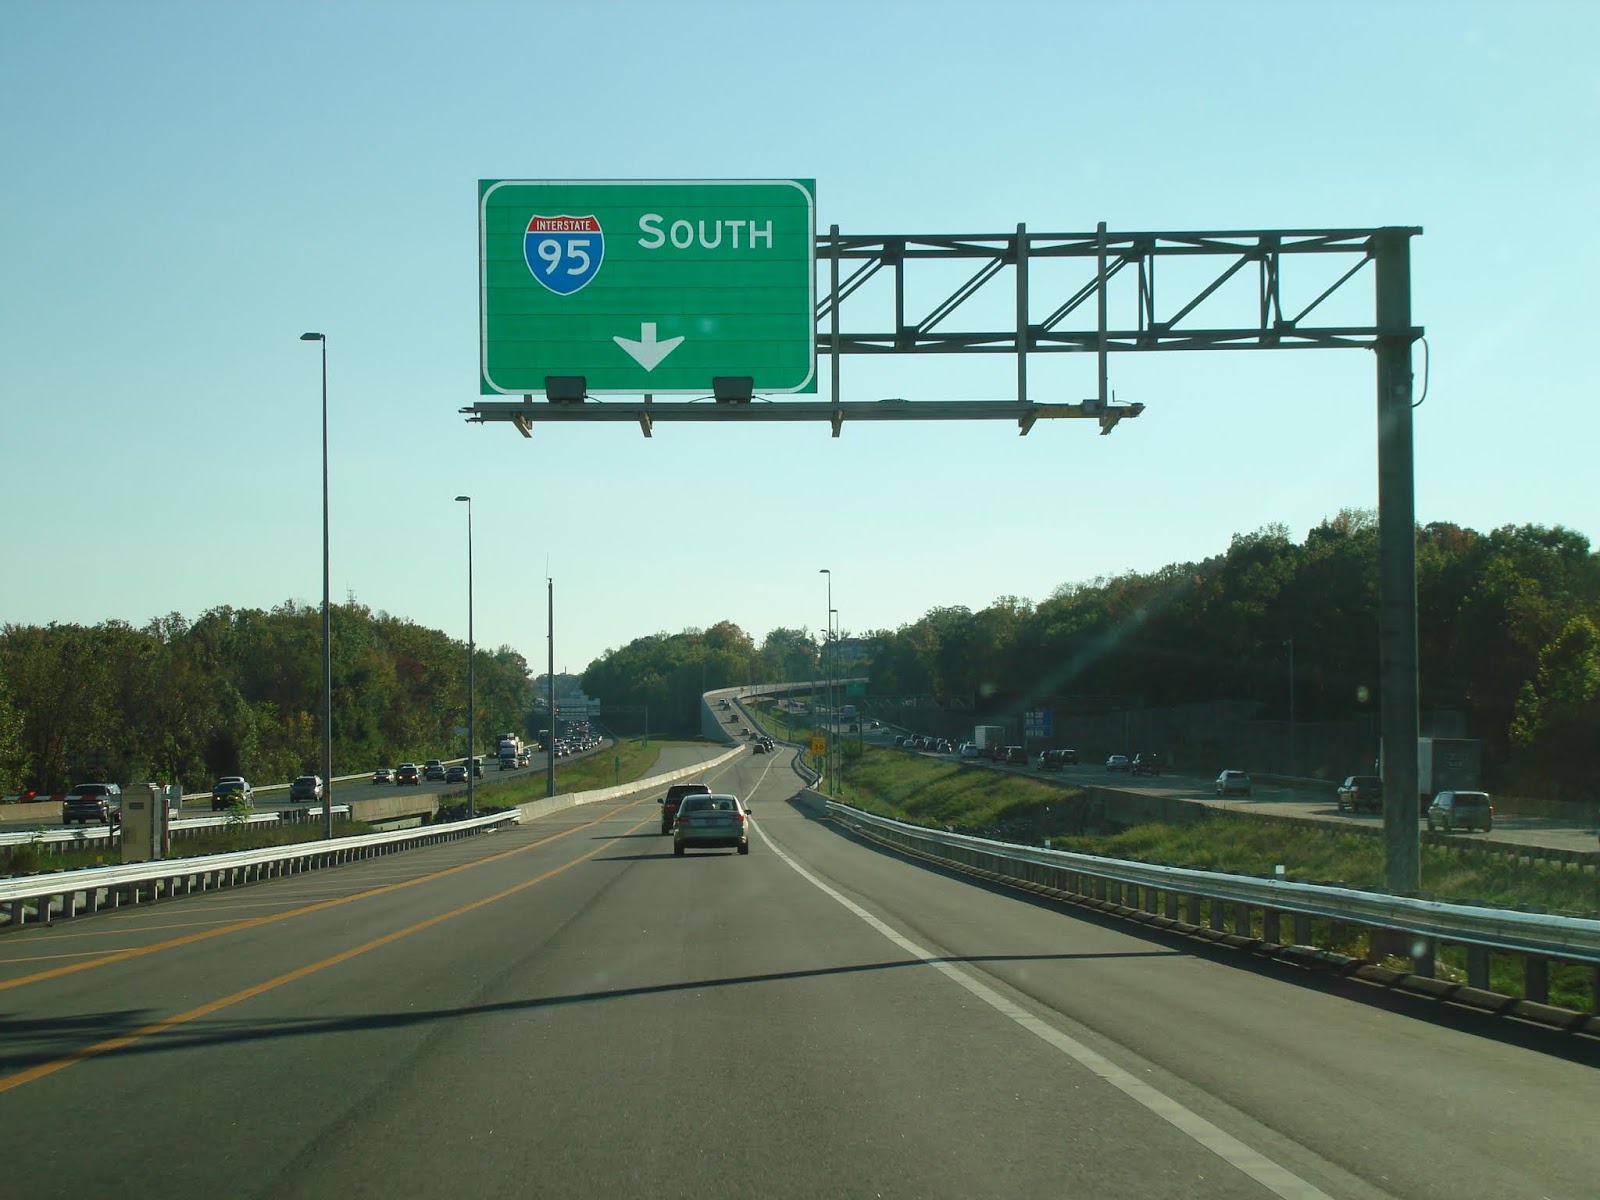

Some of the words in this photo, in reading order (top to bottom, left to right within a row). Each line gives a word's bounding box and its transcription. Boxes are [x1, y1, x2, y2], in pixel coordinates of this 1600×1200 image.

[536, 220, 591, 231] INTERSTATE
[638, 213, 772, 249] SOUTH
[538, 239, 590, 276] 95
